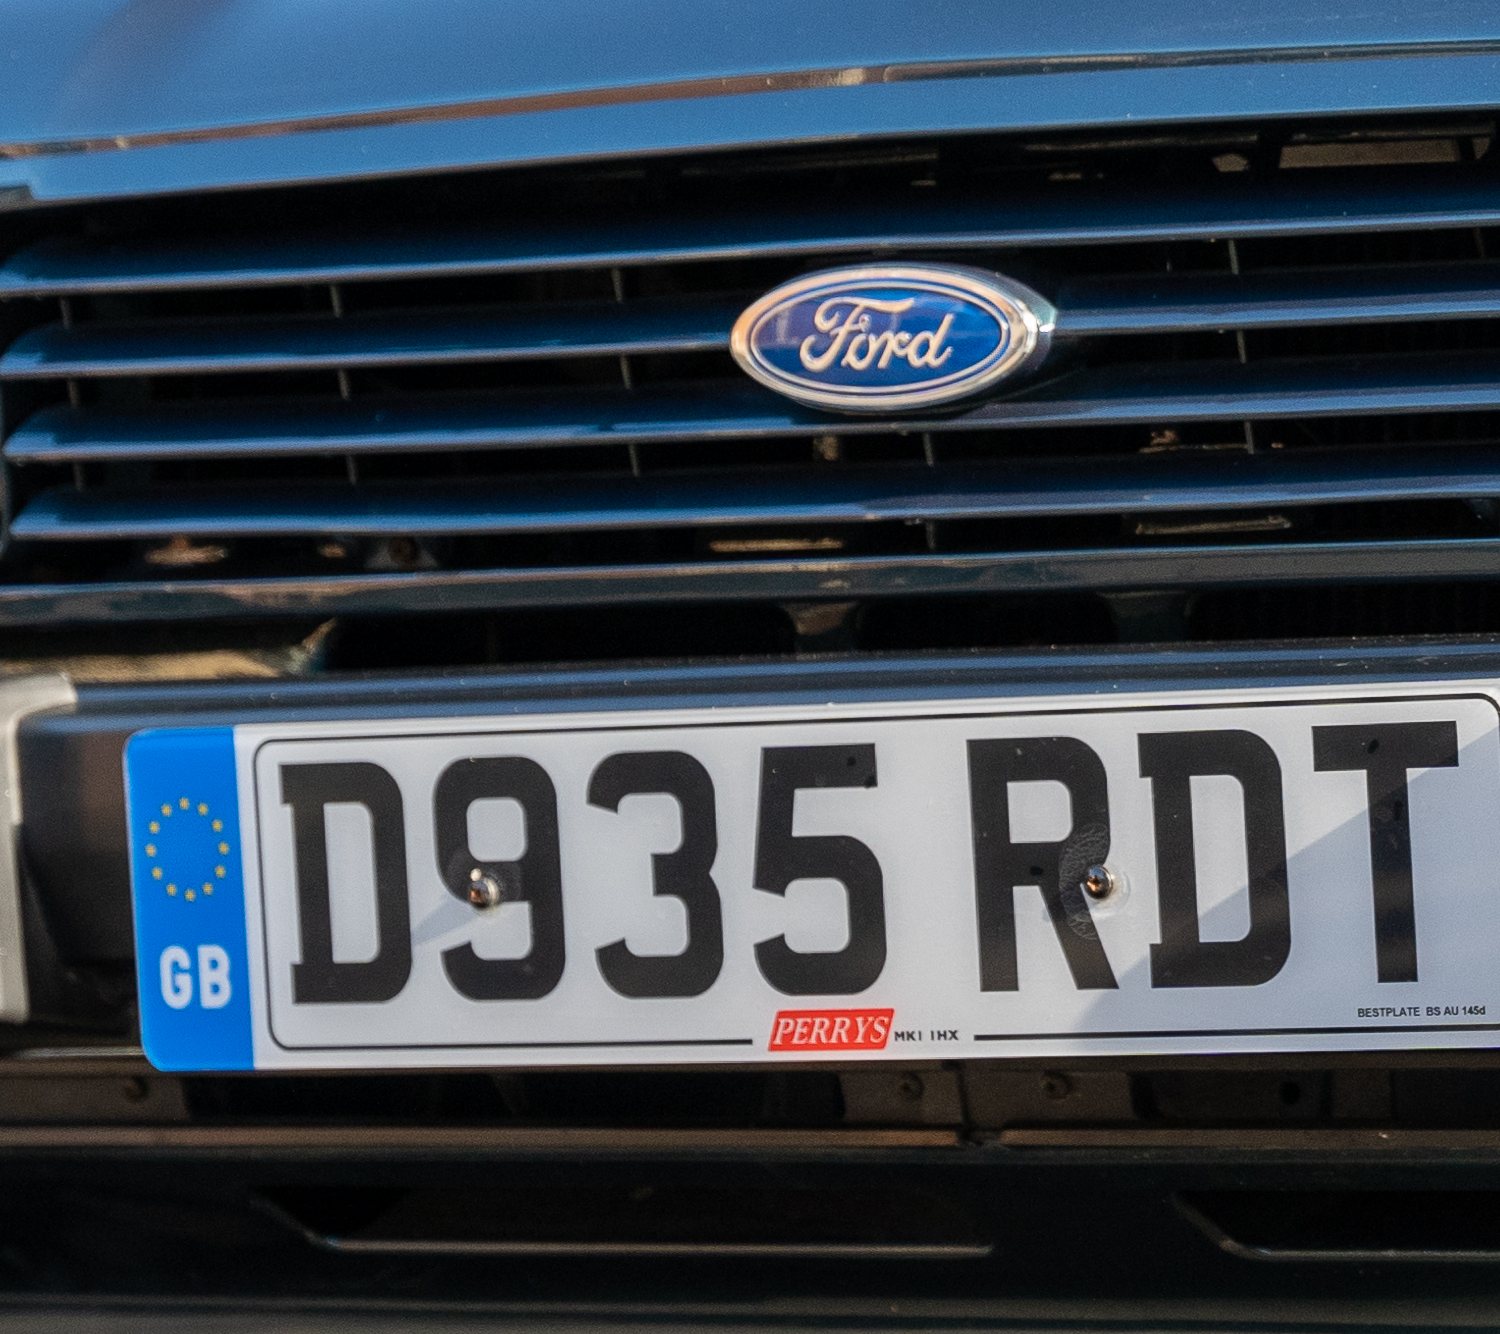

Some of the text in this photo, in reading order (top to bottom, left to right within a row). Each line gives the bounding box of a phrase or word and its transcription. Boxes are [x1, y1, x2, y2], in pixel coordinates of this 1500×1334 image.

[799, 296, 956, 372] Ford
[277, 720, 1460, 1006] D935 RDT
[159, 944, 232, 1010] GB
[773, 1017, 889, 1045] PERRYS
[1357, 1006, 1486, 1017] BESTPLATE BS AU 145d
